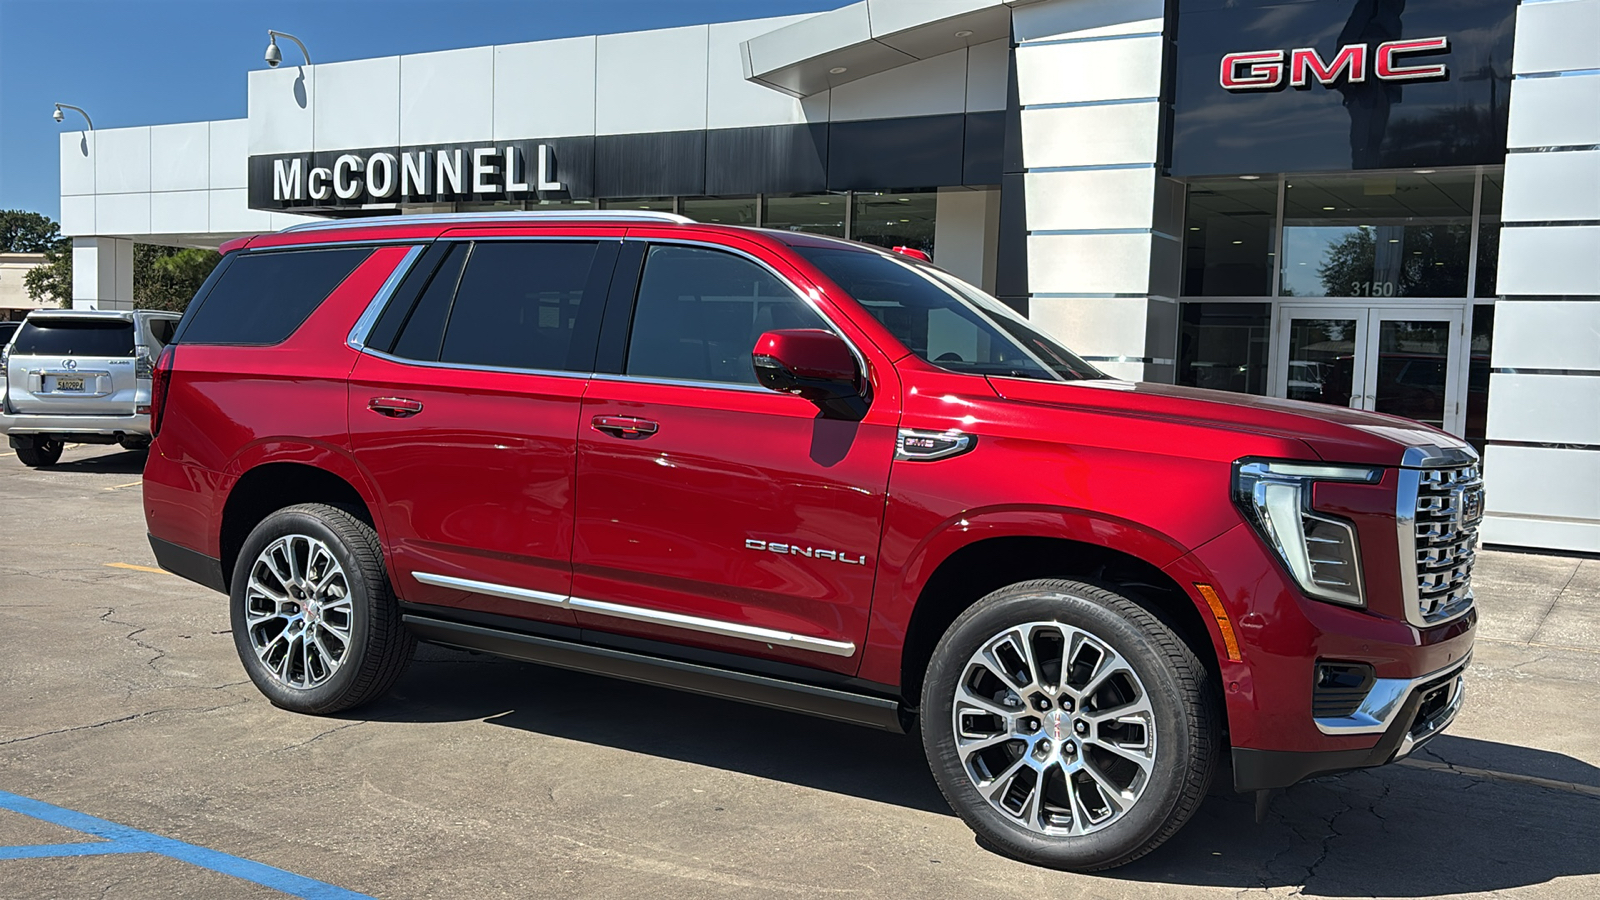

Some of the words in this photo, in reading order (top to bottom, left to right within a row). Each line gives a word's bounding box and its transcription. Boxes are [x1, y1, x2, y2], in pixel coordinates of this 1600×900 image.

[1219, 36, 1447, 90] GMC
[273, 144, 563, 200] McCONNELL
[1350, 281, 1393, 297] 3150
[745, 539, 866, 565] DENALI
